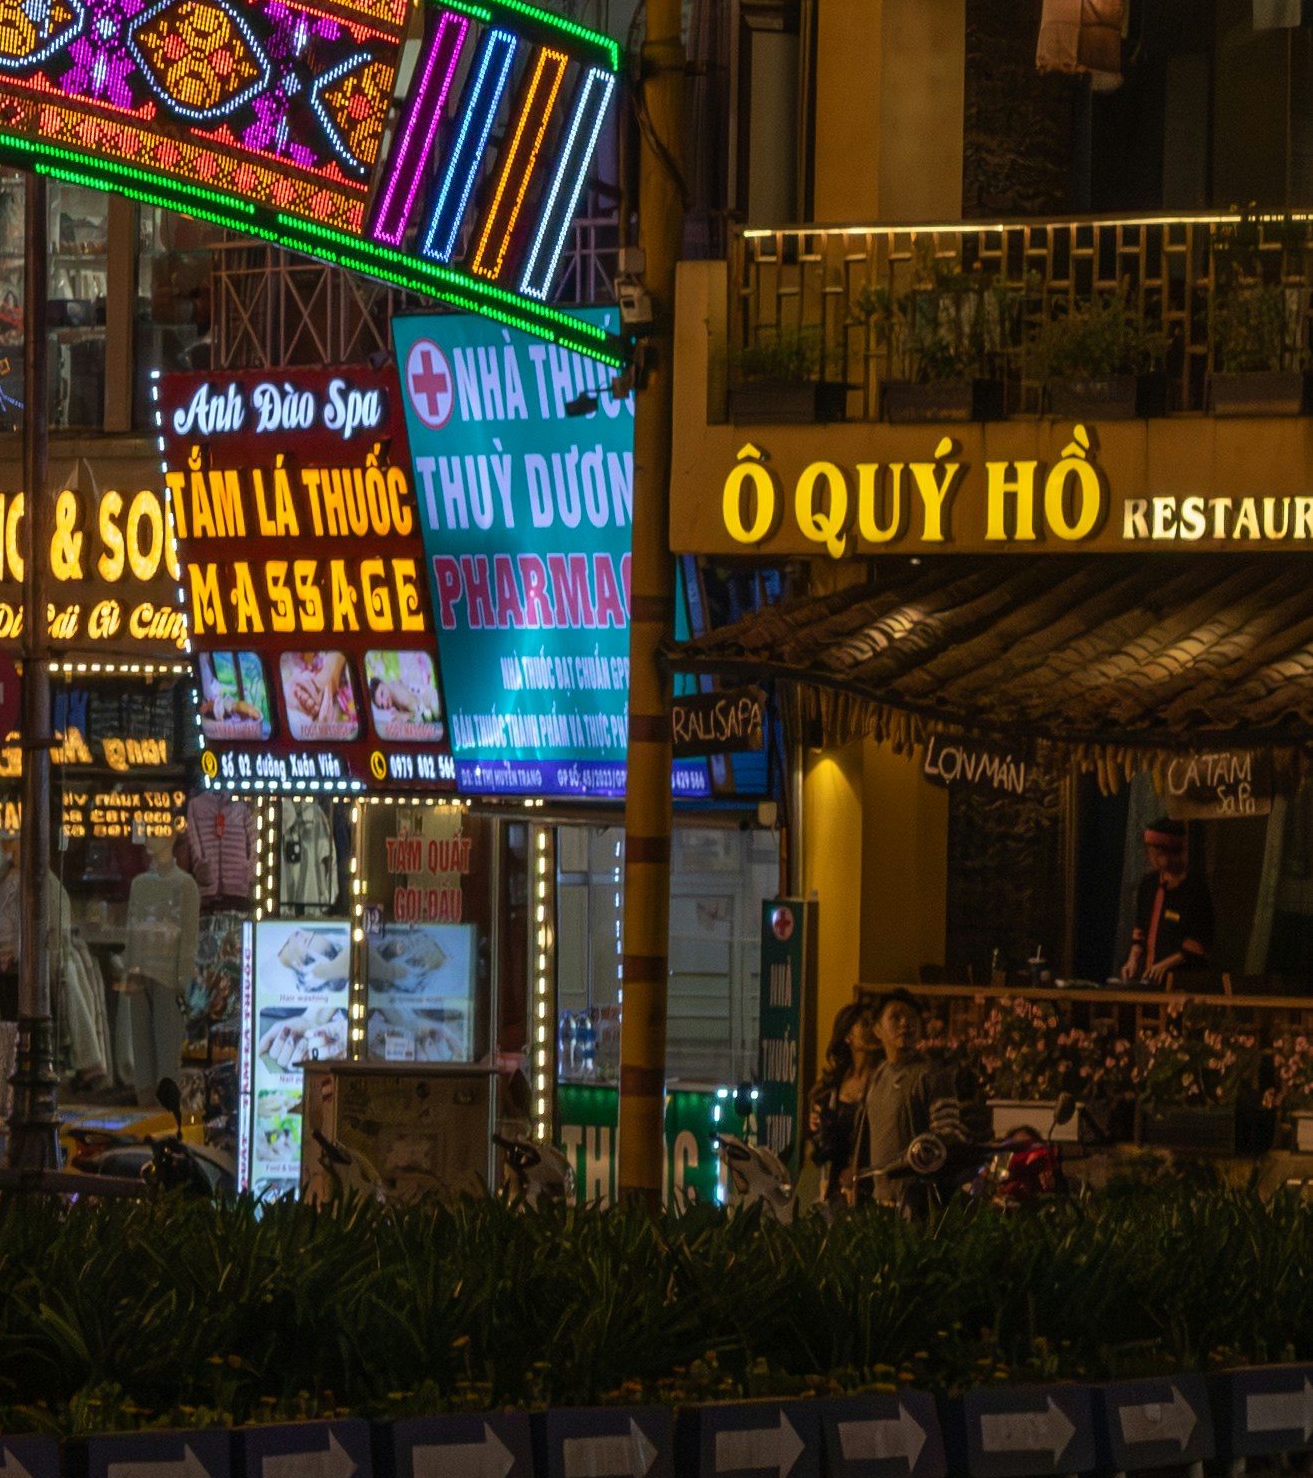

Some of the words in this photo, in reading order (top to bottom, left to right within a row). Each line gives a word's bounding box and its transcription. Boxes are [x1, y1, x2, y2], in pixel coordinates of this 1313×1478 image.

[173, 382, 245, 435] Anh
[252, 381, 315, 433] Đào
[324, 377, 381, 439] Spa
[452, 328, 529, 422] NHÀ
[165, 444, 246, 539] TẮM
[252, 453, 300, 537] LÁ
[301, 441, 413, 537] THUỐC
[722, 442, 776, 545] Ô
[794, 434, 962, 559] QUÝ
[985, 423, 1102, 542] HỒ
[50, 488, 84, 582] &
[88, 598, 122, 639] Gì
[187, 557, 425, 635] MASSAGE
[221, 750, 234, 778] Số
[238, 753, 251, 777] 02
[290, 752, 316, 778] Xuân
[318, 751, 341, 777] Viên
[389, 755, 414, 779] 0979
[417, 755, 436, 779] 802
